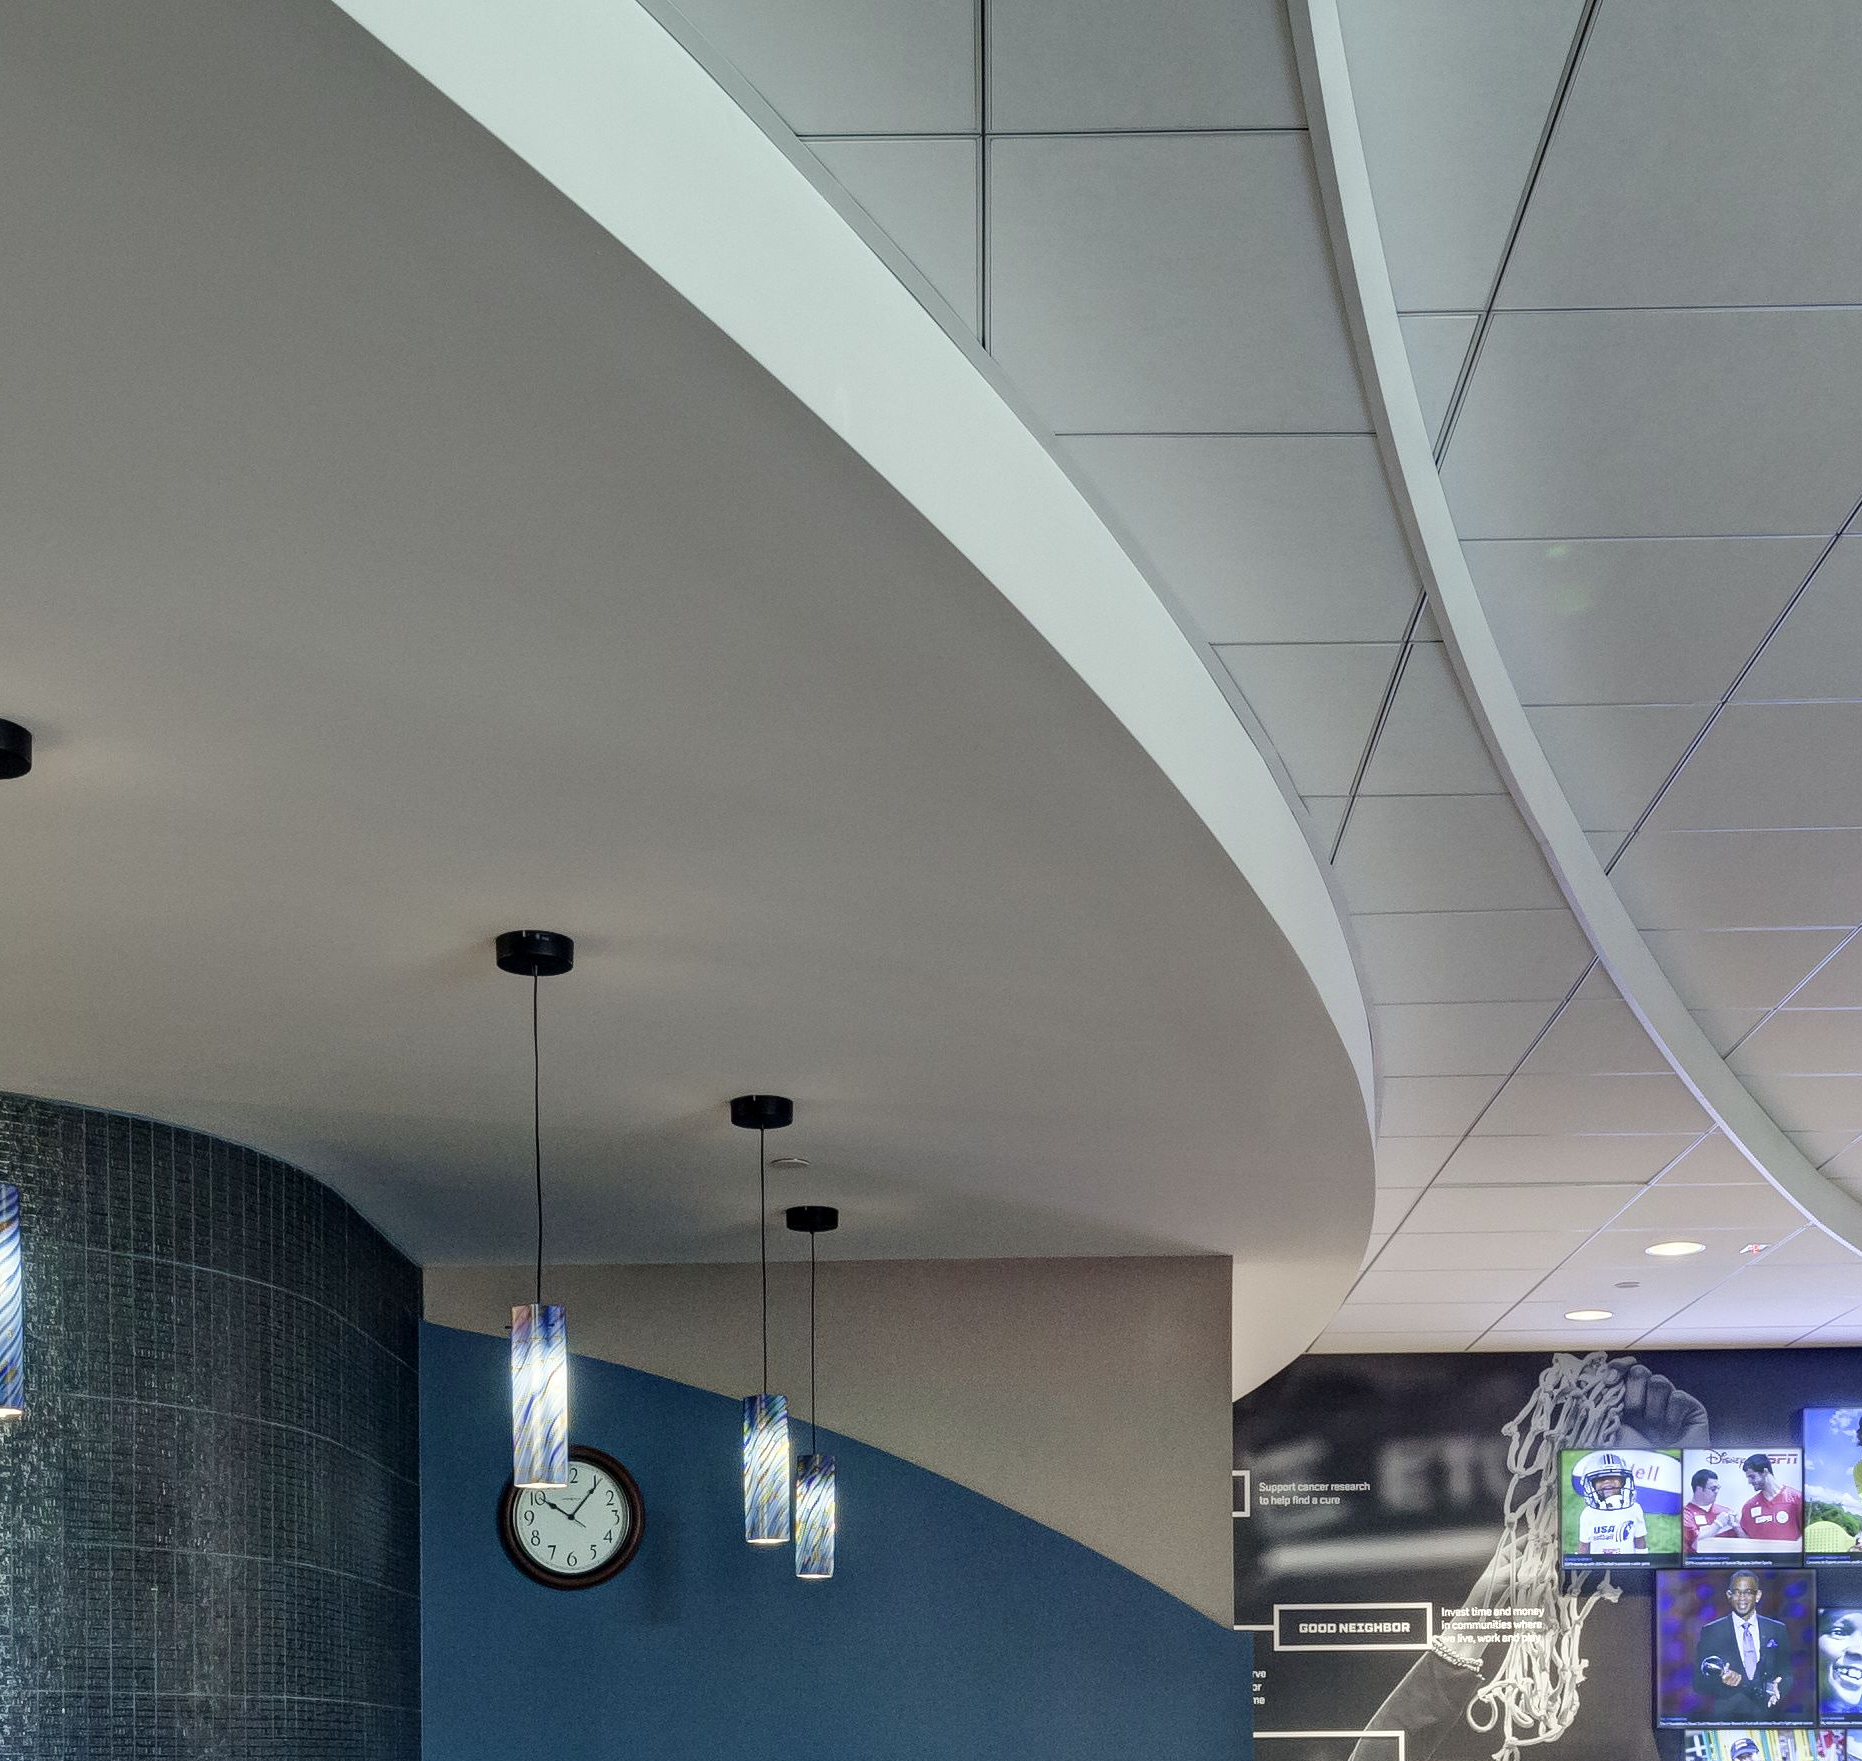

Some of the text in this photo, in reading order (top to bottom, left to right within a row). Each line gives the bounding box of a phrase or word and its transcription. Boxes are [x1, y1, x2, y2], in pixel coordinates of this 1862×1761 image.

[569, 1467, 579, 1484] 2
[1259, 1481, 1371, 1493] Support cancer research
[529, 1490, 546, 1506] 10
[605, 1489, 615, 1507] 2
[1259, 1495, 1341, 1506] to help find a cure
[523, 1510, 535, 1526] 9
[611, 1509, 620, 1526] 3
[603, 1529, 613, 1544] 4
[1593, 1525, 1615, 1534] USA
[530, 1529, 541, 1547] 8
[547, 1544, 557, 1561] 7
[566, 1550, 578, 1567] 6
[589, 1544, 598, 1561] 5
[1441, 1606, 1545, 1618] Invest time and money
[1298, 1621, 1411, 1634] GOOD NEIGHBOR
[1441, 1620, 1543, 1630] in communities where
[1457, 1633, 1476, 1644] live,
[1477, 1633, 1501, 1643] work
[1502, 1633, 1520, 1643] and
